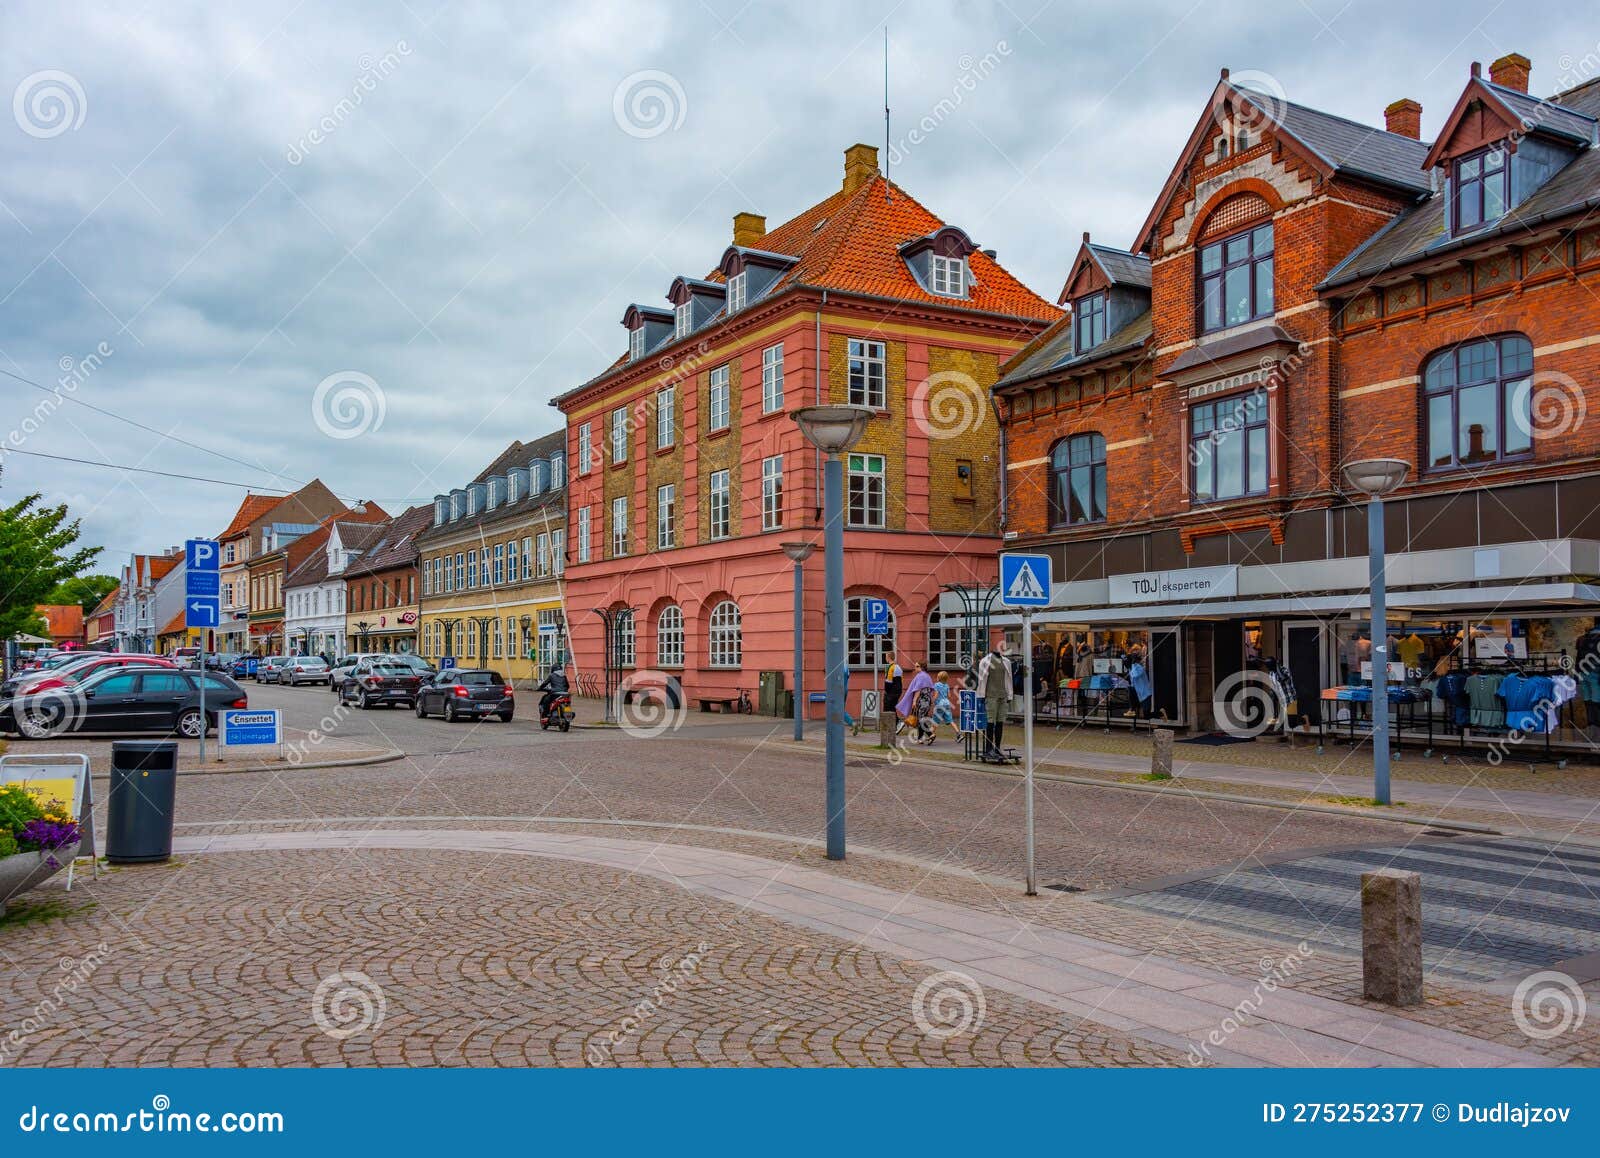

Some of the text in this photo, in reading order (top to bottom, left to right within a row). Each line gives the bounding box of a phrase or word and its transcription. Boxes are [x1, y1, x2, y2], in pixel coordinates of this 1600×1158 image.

[195, 543, 213, 568] P
[1162, 579, 1211, 593] eksperten
[872, 602, 884, 620] P
[444, 658, 453, 669] P
[234, 715, 273, 724] Ensrettet
